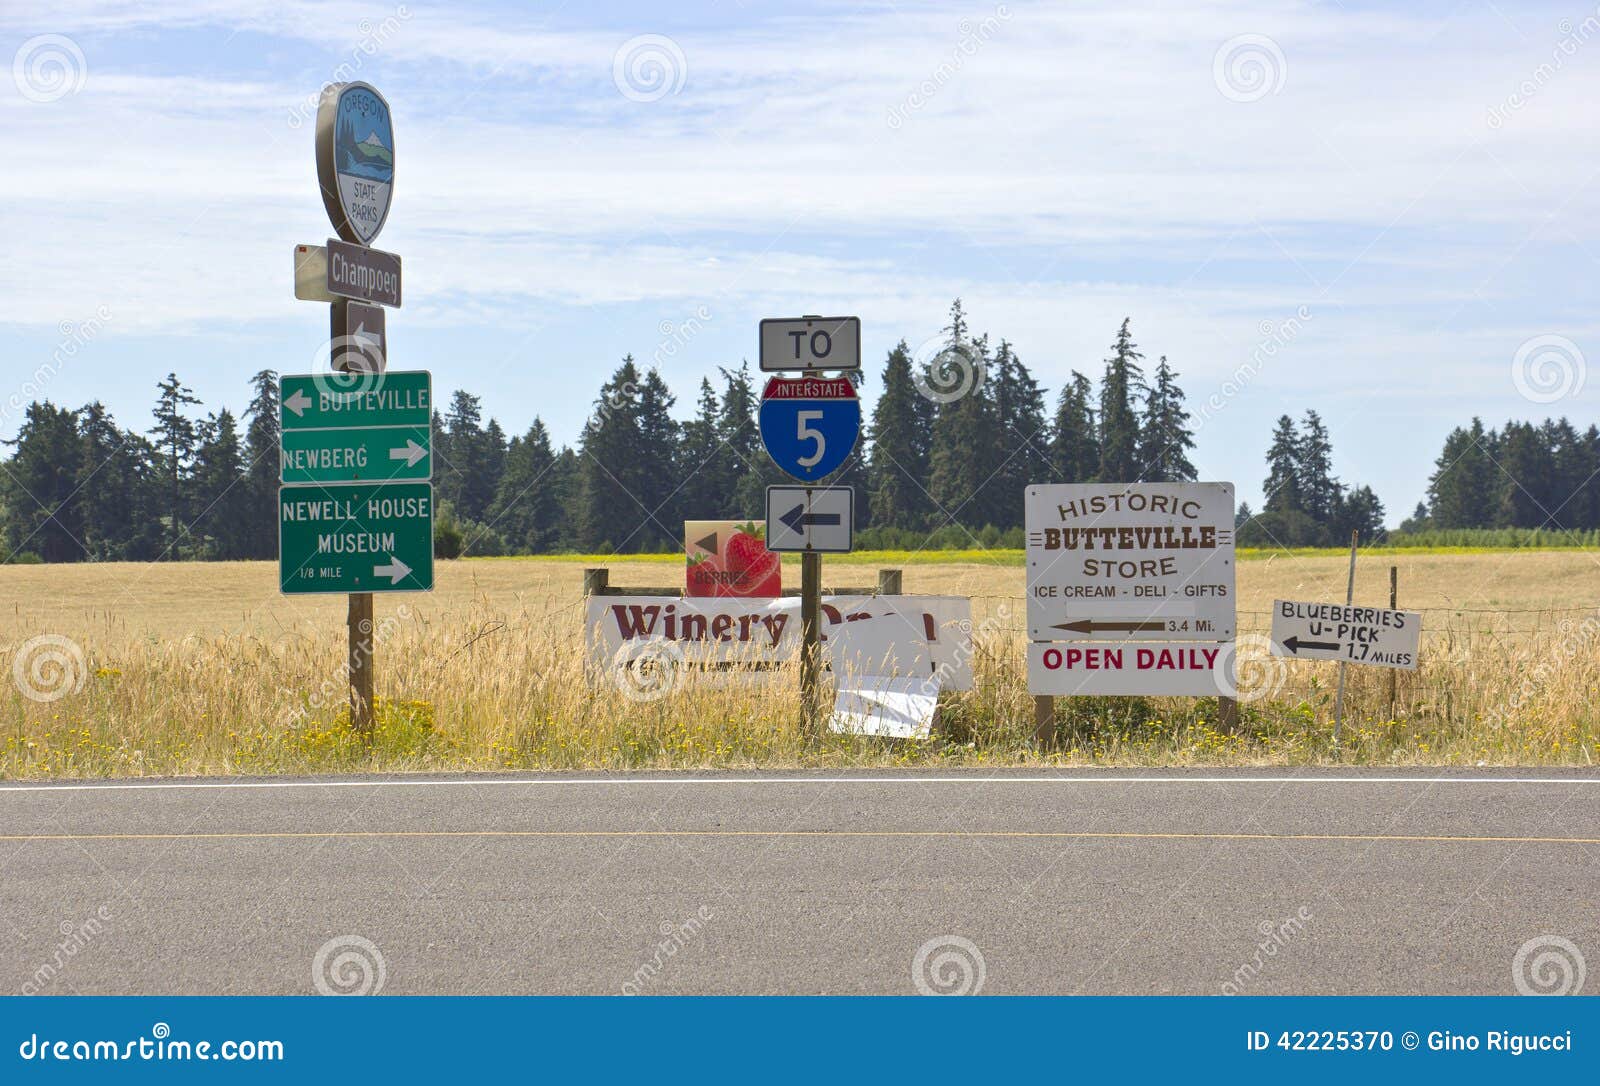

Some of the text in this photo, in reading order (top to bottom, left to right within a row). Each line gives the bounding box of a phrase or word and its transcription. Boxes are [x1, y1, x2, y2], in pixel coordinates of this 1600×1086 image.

[345, 96, 385, 123] OREGON
[354, 182, 376, 201] STATE
[352, 203, 378, 223] PARKS
[788, 330, 832, 359] TO
[319, 389, 428, 412] BUTTEVILLE
[777, 383, 846, 397] INTERSTATE
[797, 410, 826, 467] 5
[282, 447, 367, 469] NEWBERG
[283, 498, 429, 521] NEWELL HOUSE
[1058, 493, 1203, 521] HISTORIC
[318, 532, 395, 553] MUSEUM
[1044, 526, 1216, 550] BUTTEVILLE
[300, 567, 342, 579] 1/8 MILE
[695, 571, 750, 585] BERRIES
[1082, 557, 1178, 579] STORE
[1034, 585, 1057, 598] ICE
[1064, 585, 1116, 598] CREAM
[1134, 585, 1167, 597] DELI
[1184, 584, 1227, 597] GIFTS
[611, 604, 789, 647] Winery
[1168, 620, 1216, 632] 3.4 Mi.
[1281, 601, 1405, 629] BLUEBERRIES
[1310, 621, 1379, 643] U-PICK
[1042, 648, 1220, 670] OPEN DAILY
[1346, 643, 1412, 665] 1.7 MILES
